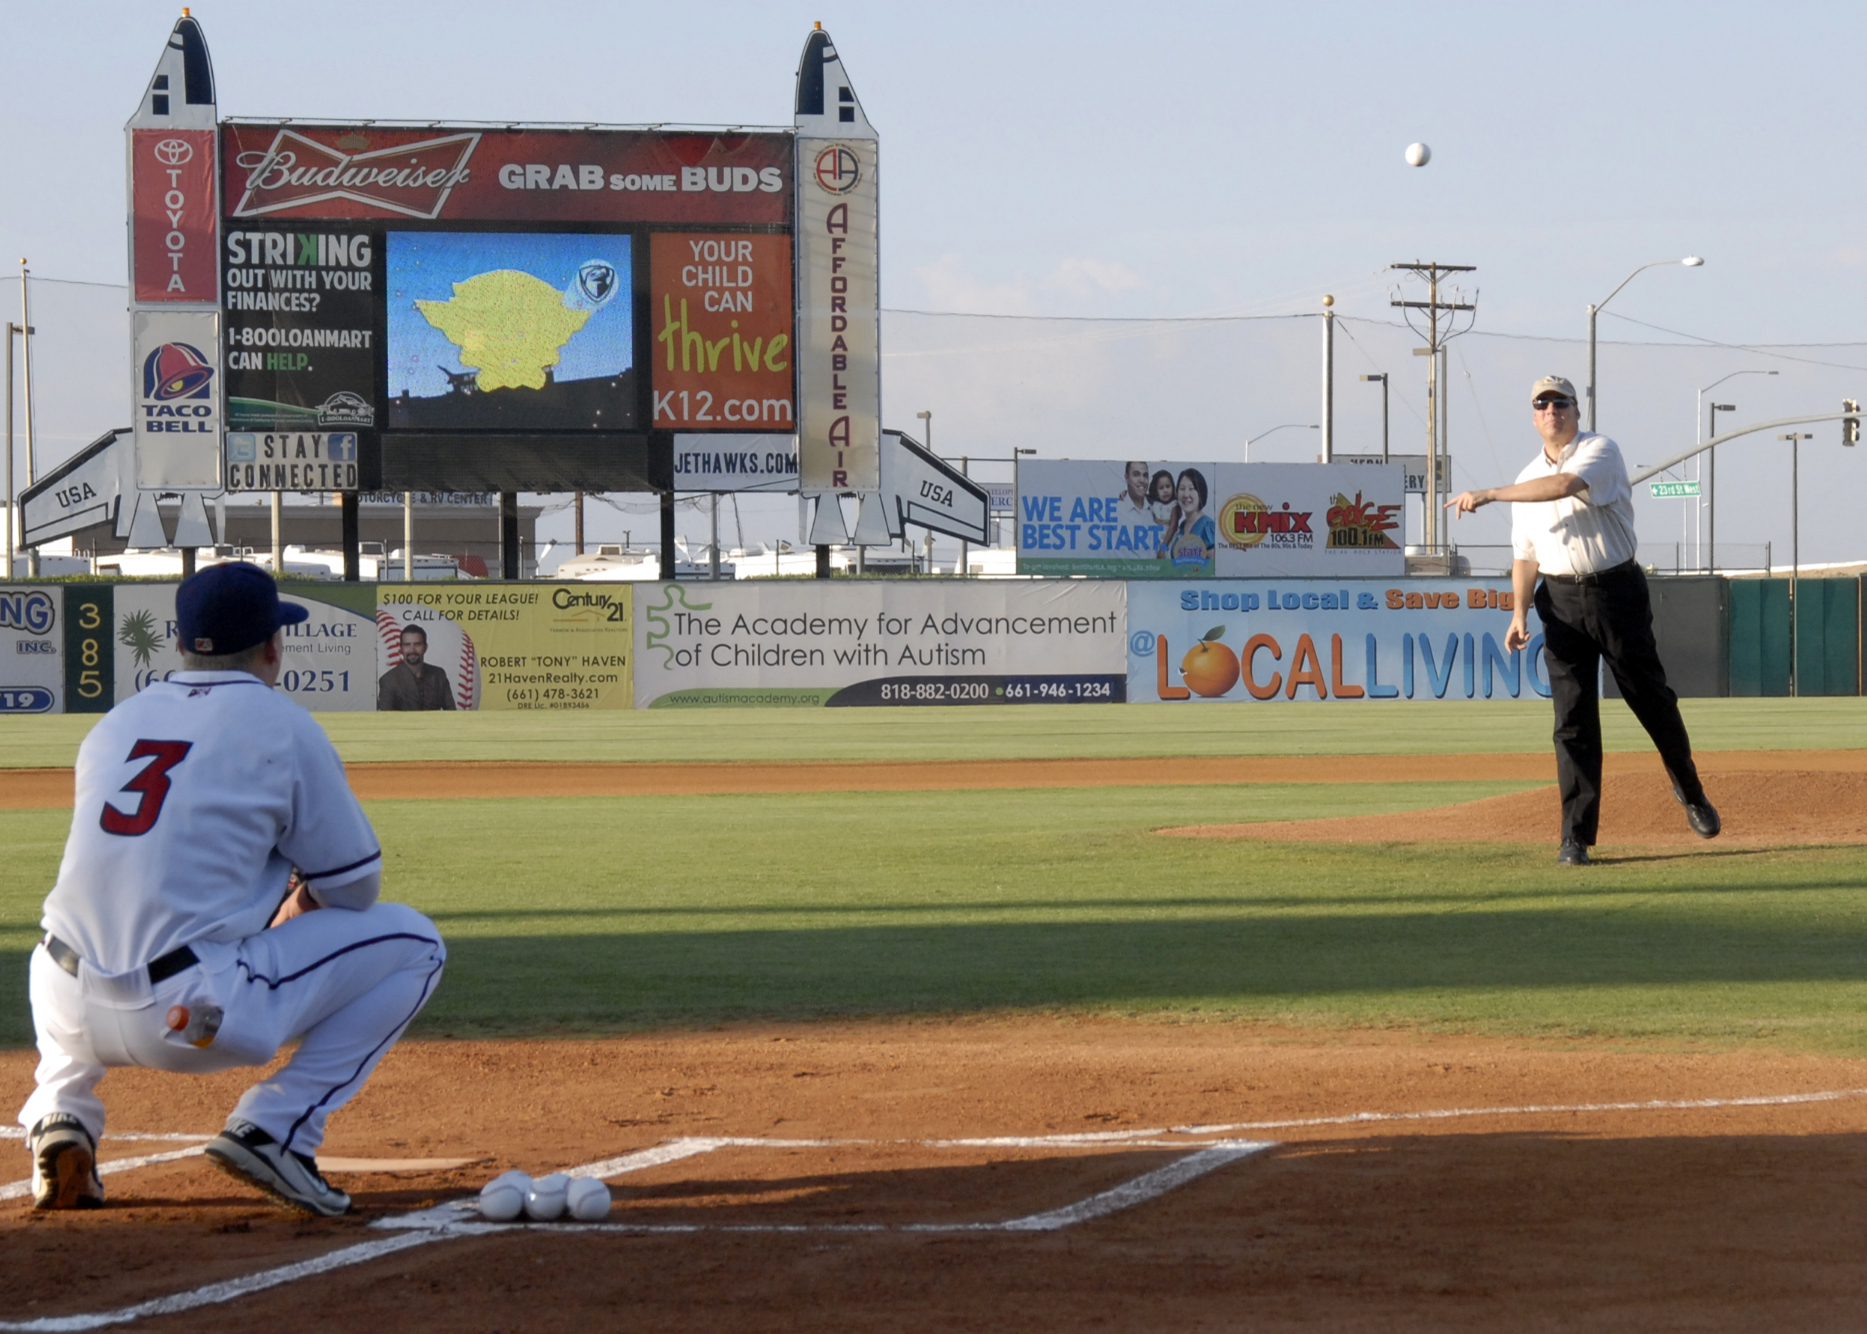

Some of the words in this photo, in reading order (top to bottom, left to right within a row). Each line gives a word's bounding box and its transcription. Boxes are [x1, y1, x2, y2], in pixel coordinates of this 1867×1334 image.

[236, 151, 470, 191] Budweiser
[498, 163, 605, 191] GRAB
[609, 174, 677, 191] SOME
[681, 166, 783, 193] BUDS
[165, 169, 186, 292] TOYOTA
[227, 231, 371, 267] STRIKING
[689, 240, 754, 262] YOUR
[227, 269, 265, 288] OUT
[270, 270, 317, 289] WITH
[322, 271, 372, 291] YOUR
[681, 266, 754, 288] CHILD
[227, 292, 321, 312] FINANCES?
[704, 291, 753, 313] CAN
[826, 203, 849, 410] AFFORDABLE
[228, 327, 373, 348] 1-800LOANMART
[658, 293, 789, 373] thrive
[228, 352, 262, 370] CAN
[267, 352, 313, 371] HELP.
[141, 404, 212, 417] TACO
[652, 390, 793, 421] K12.com
[146, 420, 213, 433] BELL
[264, 434, 322, 459] STAY
[829, 416, 850, 487] AIR
[674, 452, 798, 475] JETHAWKS.COM
[230, 463, 357, 489] CONNECTED
[56, 482, 97, 508] USA
[447, 493, 488, 505] CENTER
[919, 480, 954, 508] USA
[1022, 496, 1062, 522] WE
[1069, 496, 1119, 523] ARE
[1022, 523, 1082, 550] BEST
[1088, 525, 1165, 551] START
[1270, 533, 1296, 543] 106.3
[1297, 534, 1314, 543] FM
[1331, 527, 1368, 546] 100.1
[1368, 533, 1384, 546] FM
[383, 593, 413, 606] $100
[417, 593, 442, 604] FOR
[446, 593, 482, 604] YOUR
[486, 593, 539, 604] LEAGUE!
[552, 588, 612, 610] Century
[1180, 589, 1260, 612] Shop
[1267, 589, 1350, 611] Local
[1356, 591, 1379, 611] &
[1385, 588, 1460, 610] Save
[1467, 588, 1533, 611] Big
[0, 596, 49, 630] NG
[402, 610, 435, 621] CALL
[438, 610, 464, 621] FOR
[467, 609, 520, 621] DETAILS!
[606, 602, 624, 622] 21
[285, 623, 358, 638] ILLAGE
[674, 612, 722, 635] The
[731, 612, 869, 641] Academy
[877, 612, 913, 635] for
[920, 611, 1117, 635] Advancement
[18, 641, 56, 654] INC.
[317, 643, 351, 655] Living
[675, 643, 702, 667] of
[711, 643, 825, 667] Children
[832, 643, 888, 666] with
[898, 642, 986, 666] Autism
[1129, 629, 1156, 658] @
[480, 656, 527, 667] ROBERT
[582, 656, 626, 667] HAVEN
[273, 670, 350, 692] -0251
[488, 672, 618, 686] 21HavenRealty.com
[0, 692, 35, 708] 19
[506, 688, 539, 702] (661)
[543, 688, 599, 700] 478-3621
[669, 693, 820, 706] www.autismacademy.org
[880, 683, 989, 700] 818-882-0200
[1005, 682, 1111, 698] 661-946-1234
[99, 738, 194, 836] 3
